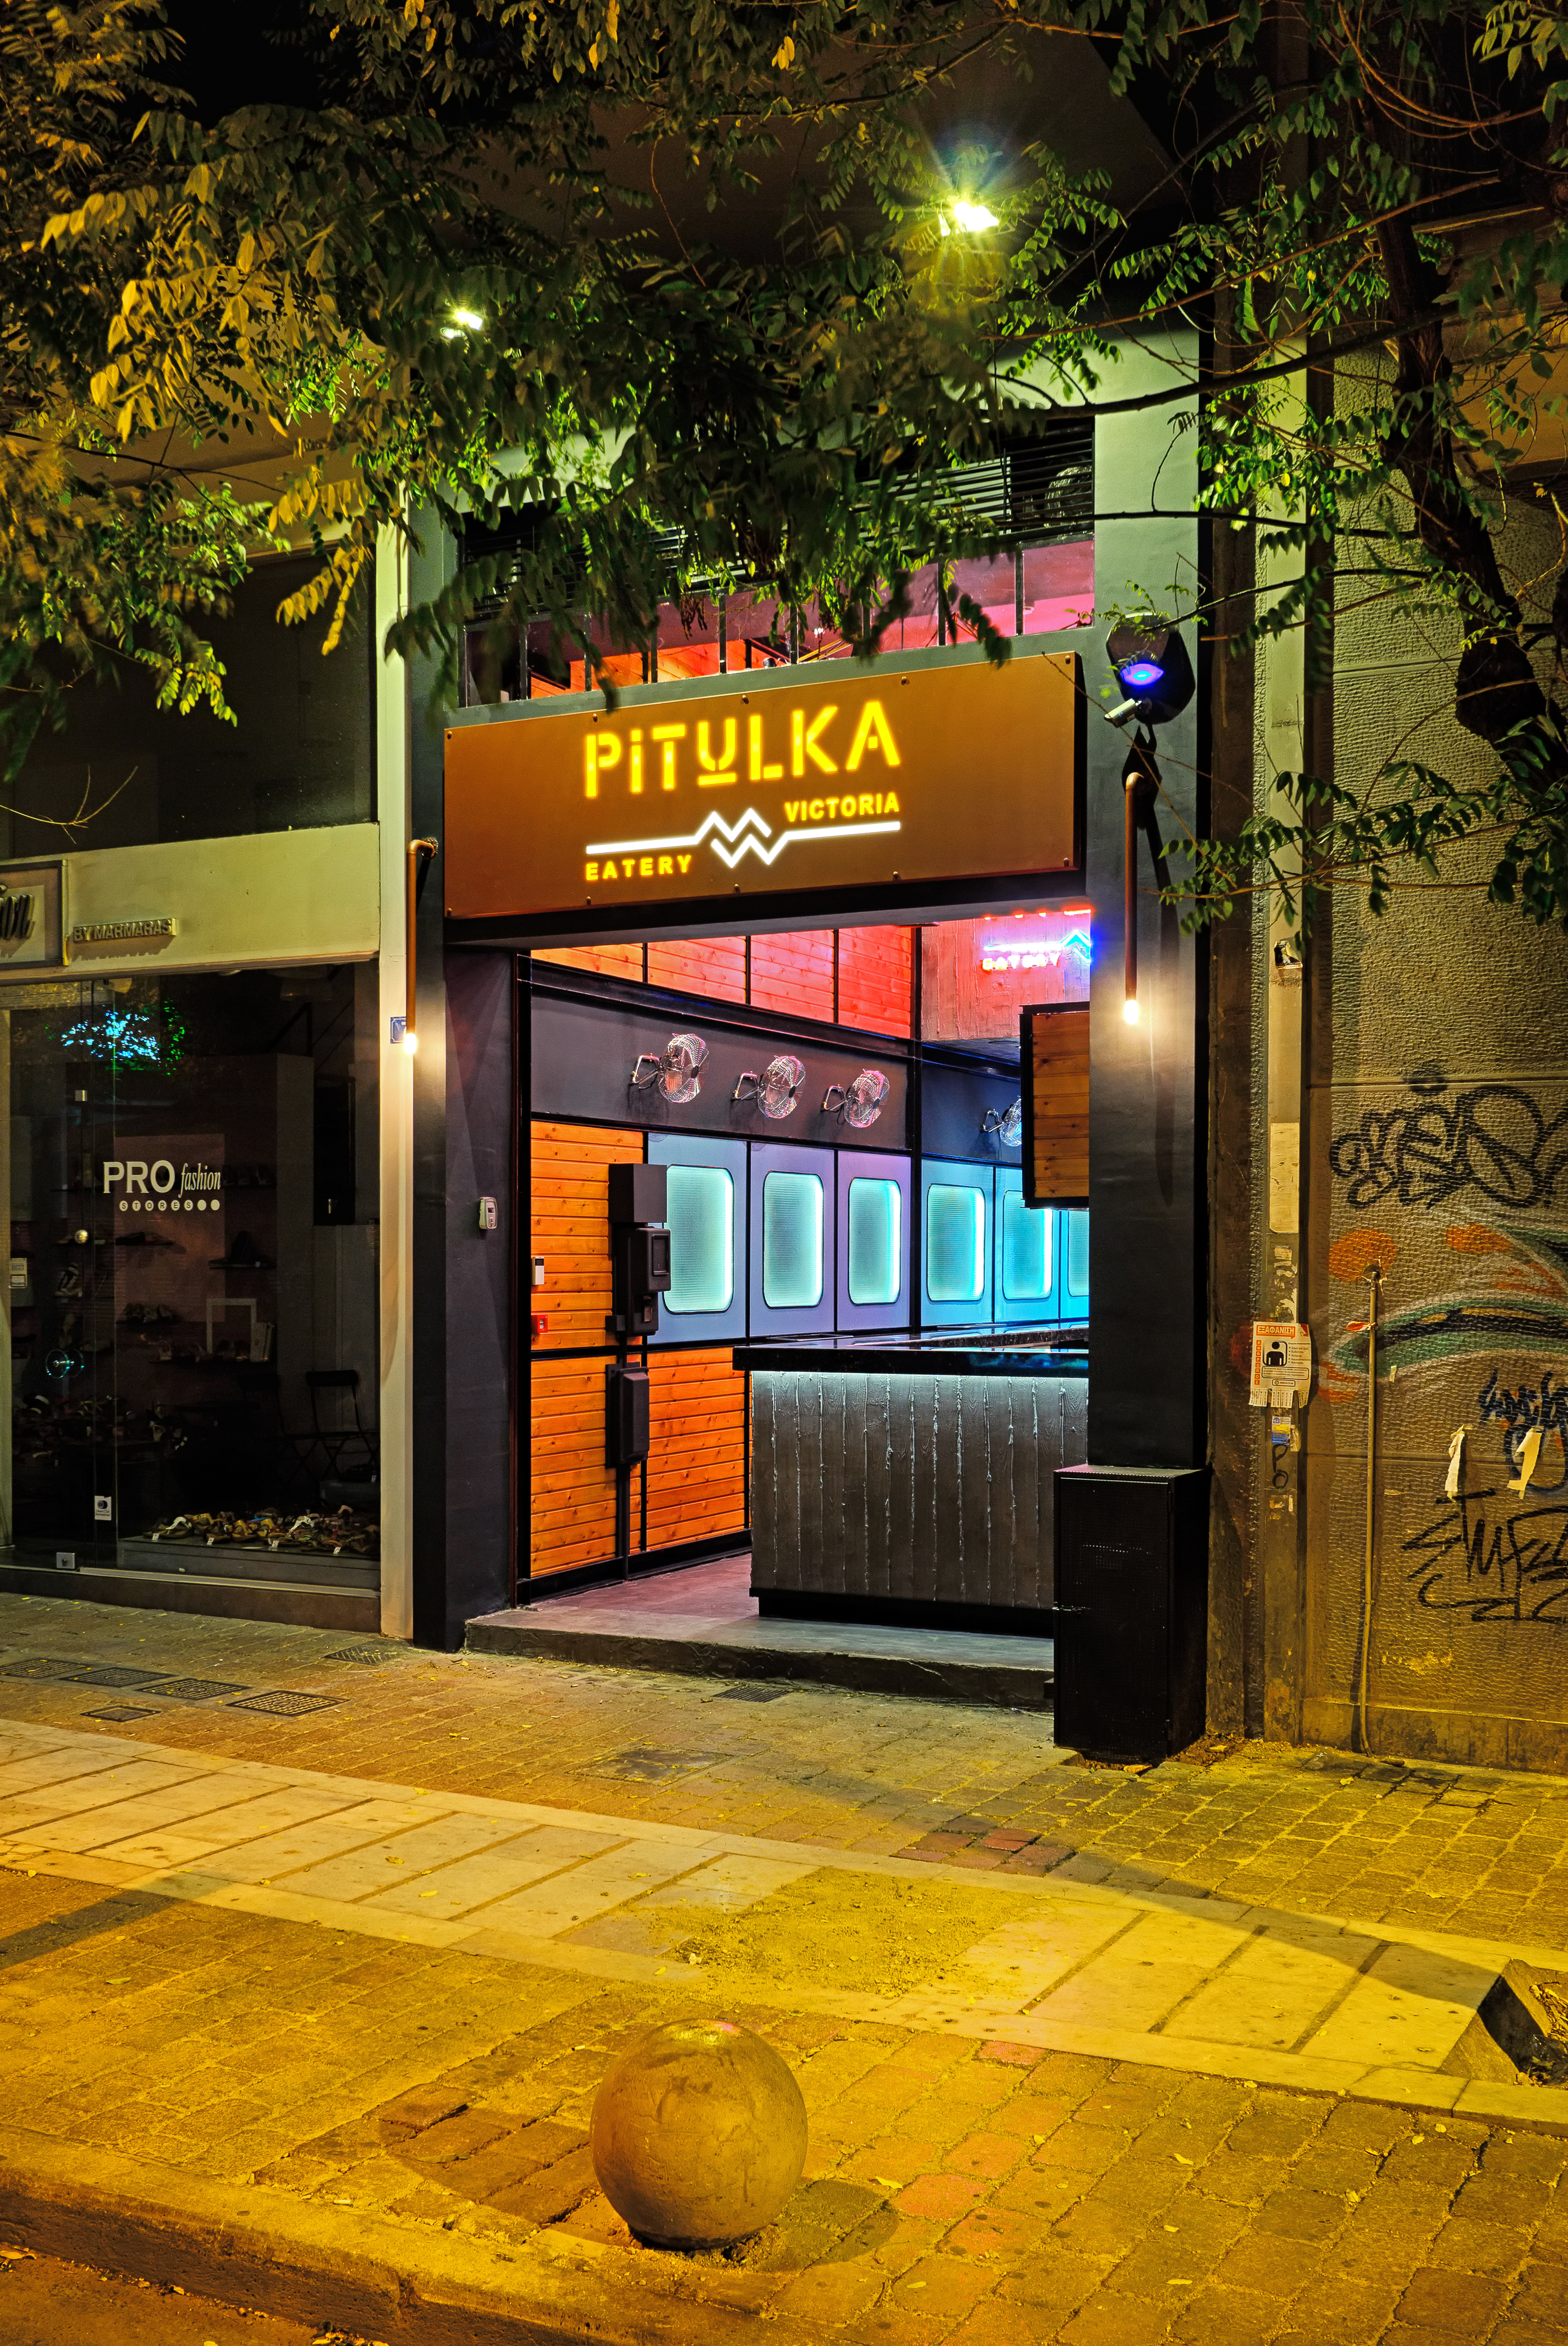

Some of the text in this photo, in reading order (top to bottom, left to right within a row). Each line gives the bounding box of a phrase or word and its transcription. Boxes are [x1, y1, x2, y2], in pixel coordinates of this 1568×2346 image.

[785, 792, 900, 822] VICTORIA
[586, 855, 692, 881] EATERY
[74, 919, 172, 942] BY MARMARAS
[103, 1160, 221, 1198] PRO fashion
[120, 1201, 192, 1211] STORES
[1257, 1325, 1295, 1334] ΕΞΑΦΑΝΙΣΗ
